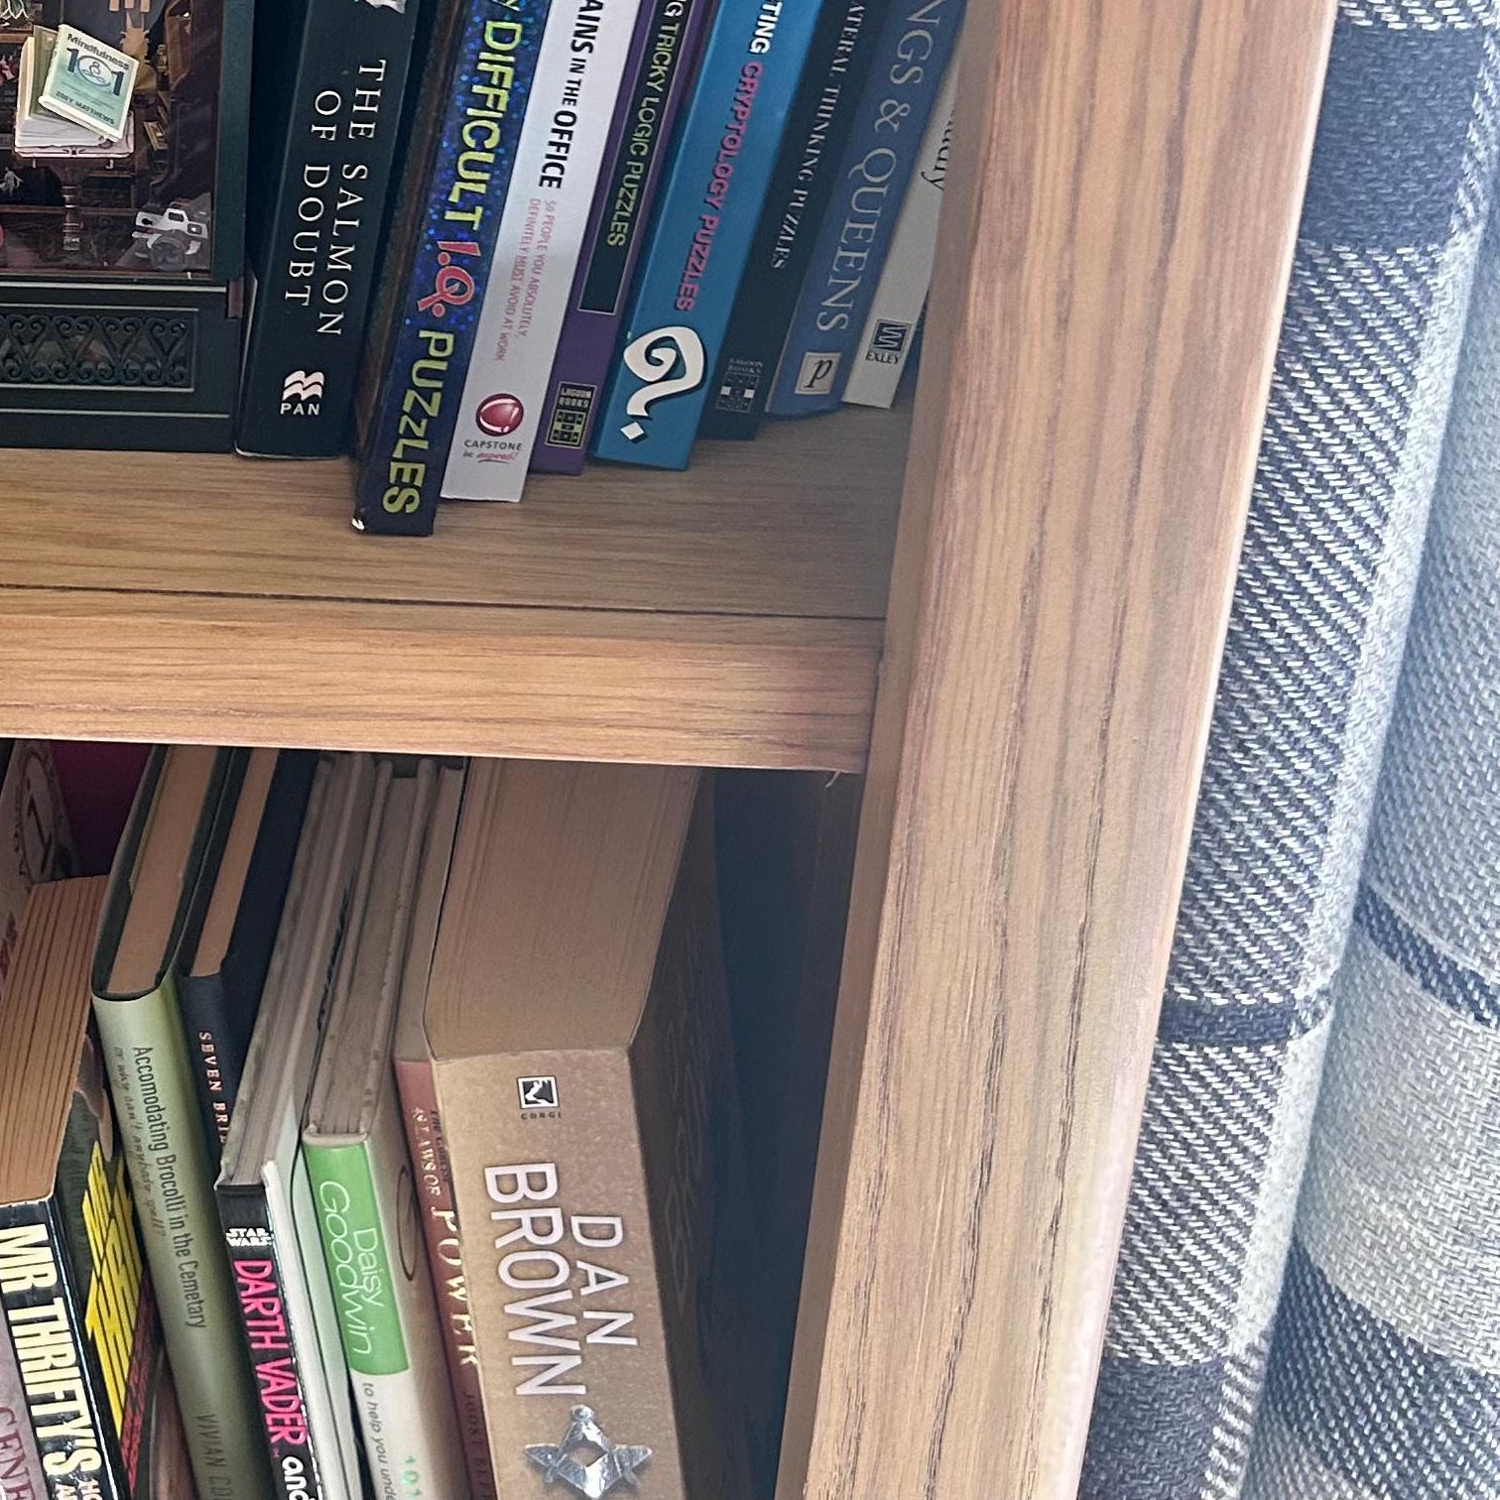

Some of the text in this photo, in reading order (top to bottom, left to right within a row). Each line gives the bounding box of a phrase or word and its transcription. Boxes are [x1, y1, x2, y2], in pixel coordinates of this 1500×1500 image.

[66, 33, 131, 71] Mindfulness
[559, 77, 579, 109] THE
[570, 57, 587, 77] IN
[647, 18, 681, 94] TRICKY
[538, 108, 578, 190] OFFICE
[626, 100, 661, 158] LOGIC
[702, 61, 764, 211] CRYPTOLOGY
[798, 83, 842, 184] THINKING
[874, 97, 911, 133] &
[284, 89, 343, 307] OF DOUBT
[317, 59, 387, 336] THE SALMON
[607, 160, 644, 249] PUZZLES
[816, 146, 897, 332] QUEENS
[381, 19, 523, 515] DIFFICULT PUZZLES
[675, 213, 723, 312] PUZZLES
[865, 351, 901, 365] EXLEY
[280, 402, 321, 417] PAN
[463, 439, 523, 451] CAPSTONE
[132, 1046, 193, 1258] Accomodating the
[520, 1110, 563, 1120] CORGI
[226, 1227, 270, 1238] STAR
[318, 1179, 377, 1355] Goodwin
[353, 1227, 387, 1309] Daisy
[484, 1161, 588, 1397] BROWN
[569, 1213, 639, 1347] DAN
[7, 1296, 103, 1477] THRIFTY'S
[232, 1257, 307, 1445] DARTH VADER
[366, 1401, 382, 1433] help
